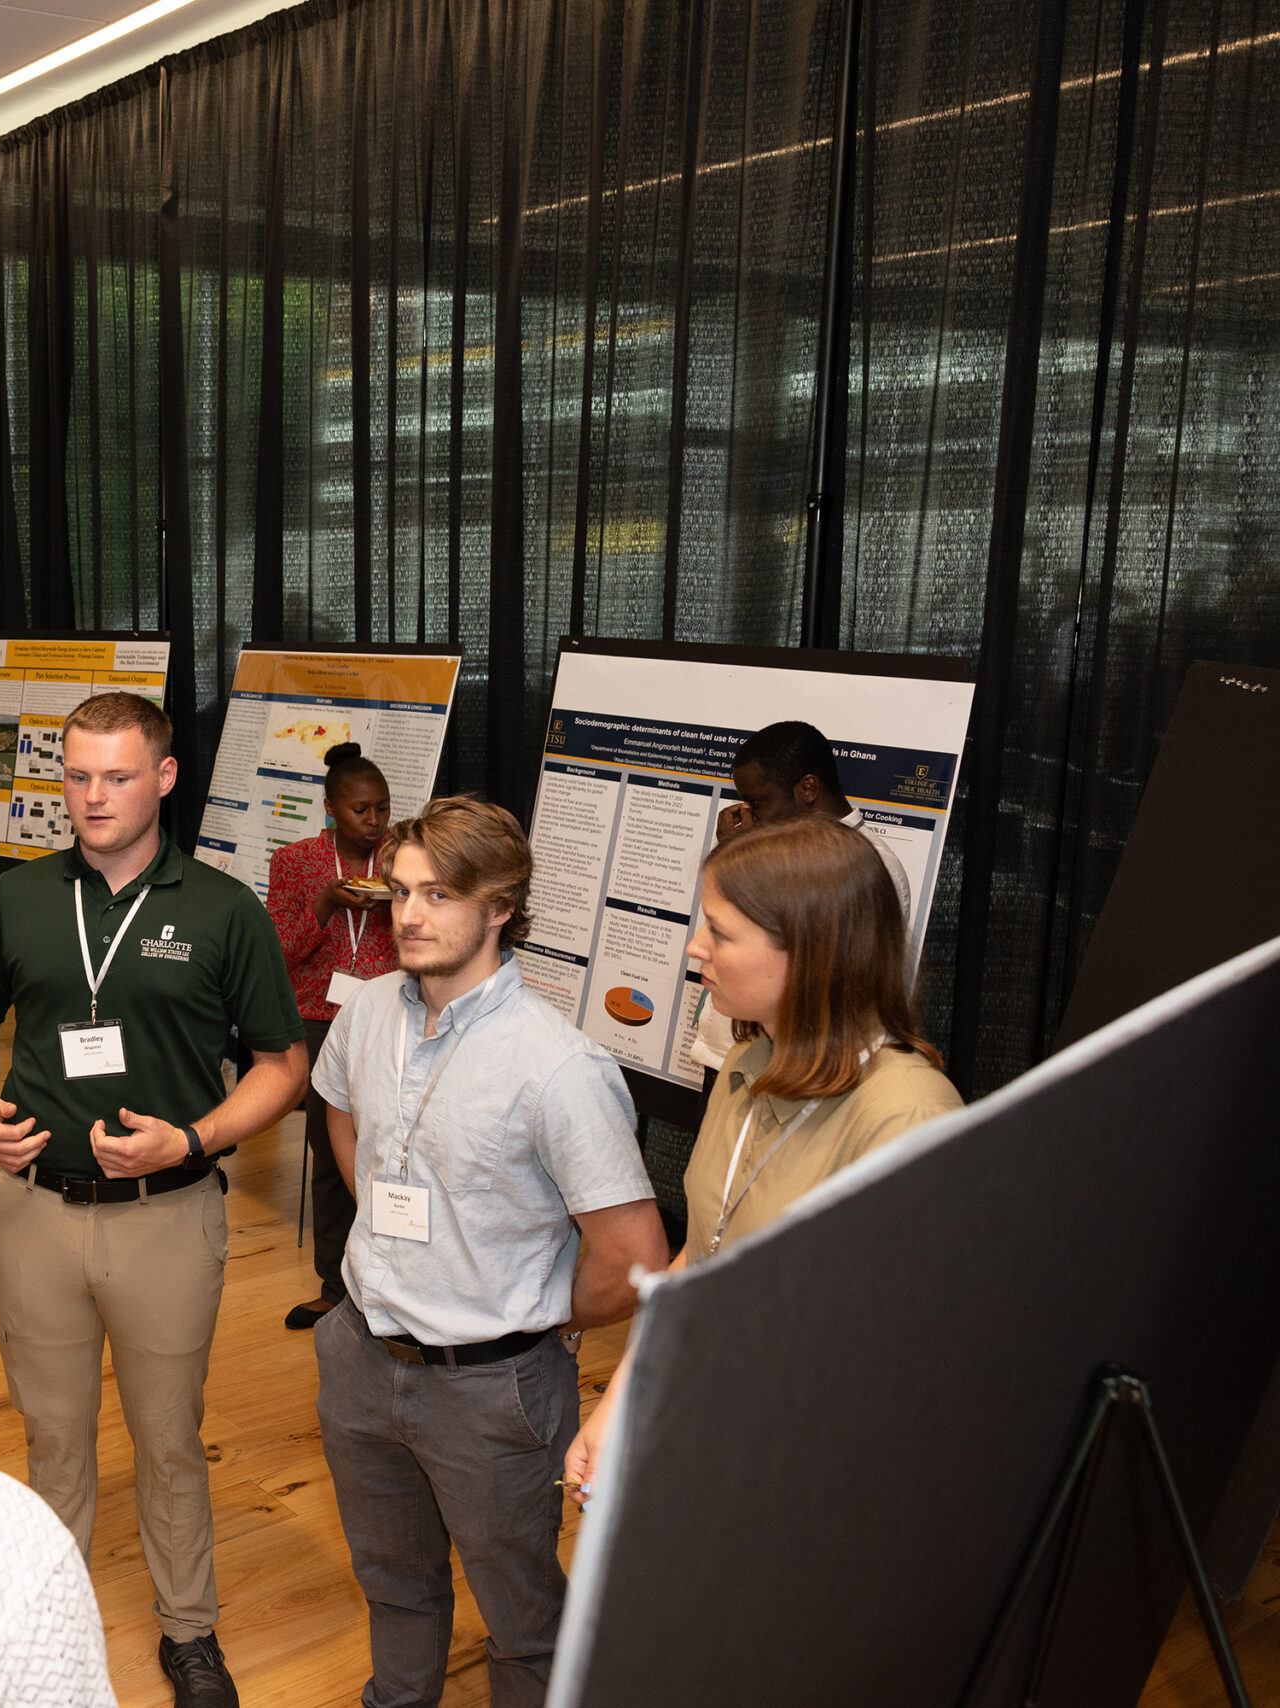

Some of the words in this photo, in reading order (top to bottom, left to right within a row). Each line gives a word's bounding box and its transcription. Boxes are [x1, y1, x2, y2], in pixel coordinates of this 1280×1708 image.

[575, 717, 630, 731] Sociodemographic
[632, 724, 671, 735] determinants
[681, 730, 698, 738] clean
[700, 732, 713, 740] fuel
[728, 735, 739, 743] for
[624, 738, 651, 748] Emmanuel
[709, 749, 727, 757] Evans
[841, 749, 848, 757] in
[850, 750, 876, 760] Ghana
[567, 766, 596, 776] Background
[658, 780, 680, 789] Methods
[917, 787, 940, 795] HEALTH
[876, 813, 902, 824] Cooking
[637, 906, 656, 915] Results
[161, 925, 175, 940] C
[140, 939, 192, 951] CHARLOTTE
[524, 943, 544, 952] Outcome
[545, 948, 576, 961] Measurement
[388, 1192, 411, 1202] Mackay
